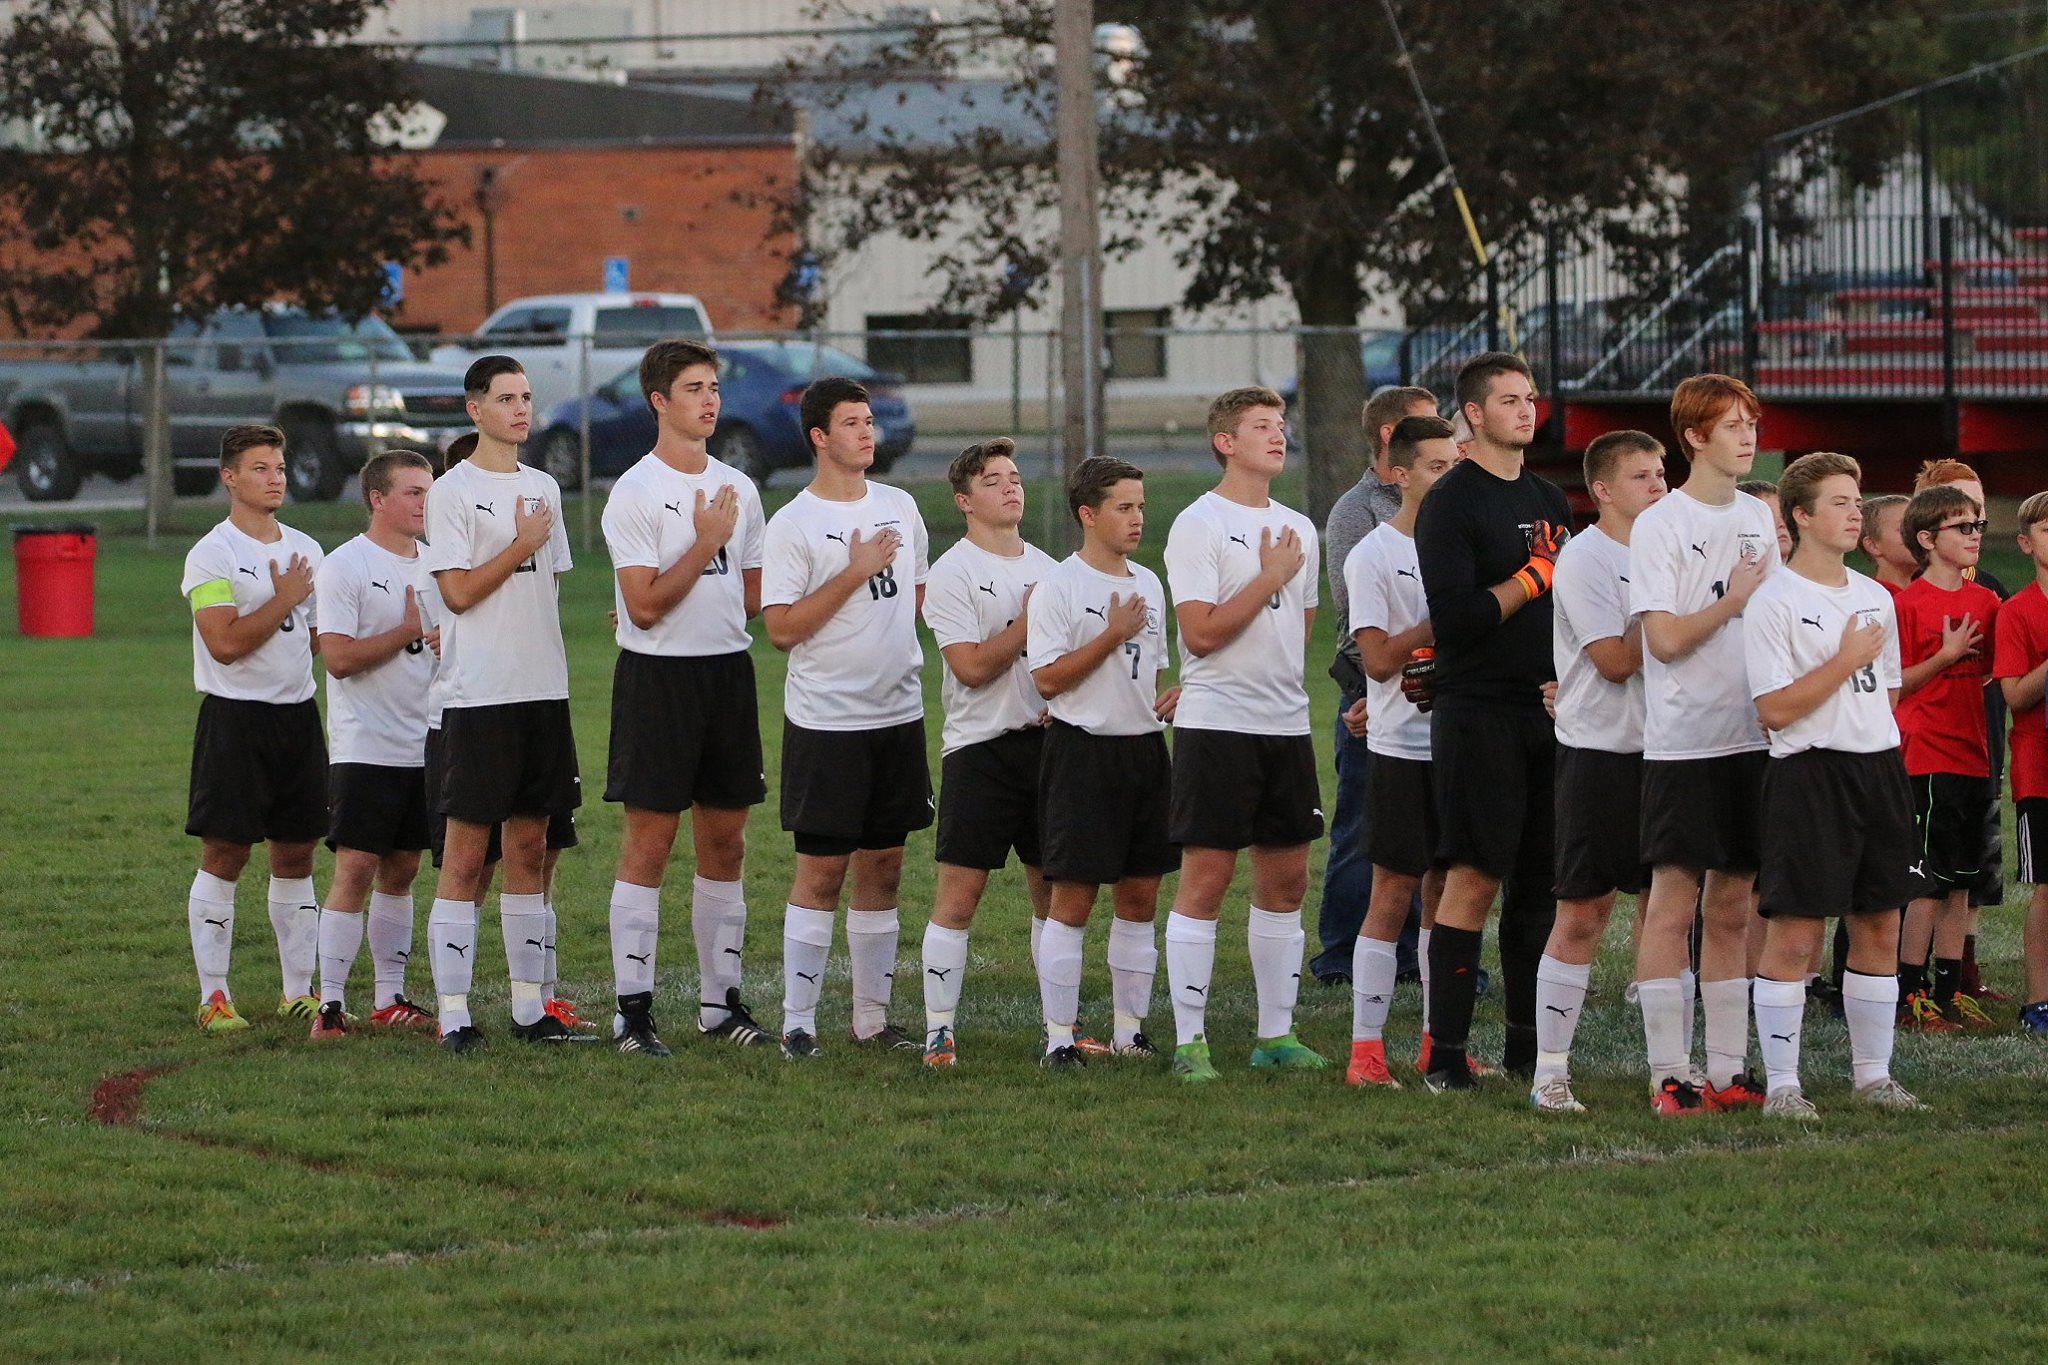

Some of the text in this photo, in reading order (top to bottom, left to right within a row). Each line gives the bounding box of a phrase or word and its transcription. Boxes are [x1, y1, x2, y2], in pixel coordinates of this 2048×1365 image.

[868, 562, 898, 601] 18
[1125, 642, 1141, 680] 7
[1851, 661, 1877, 693] 13
